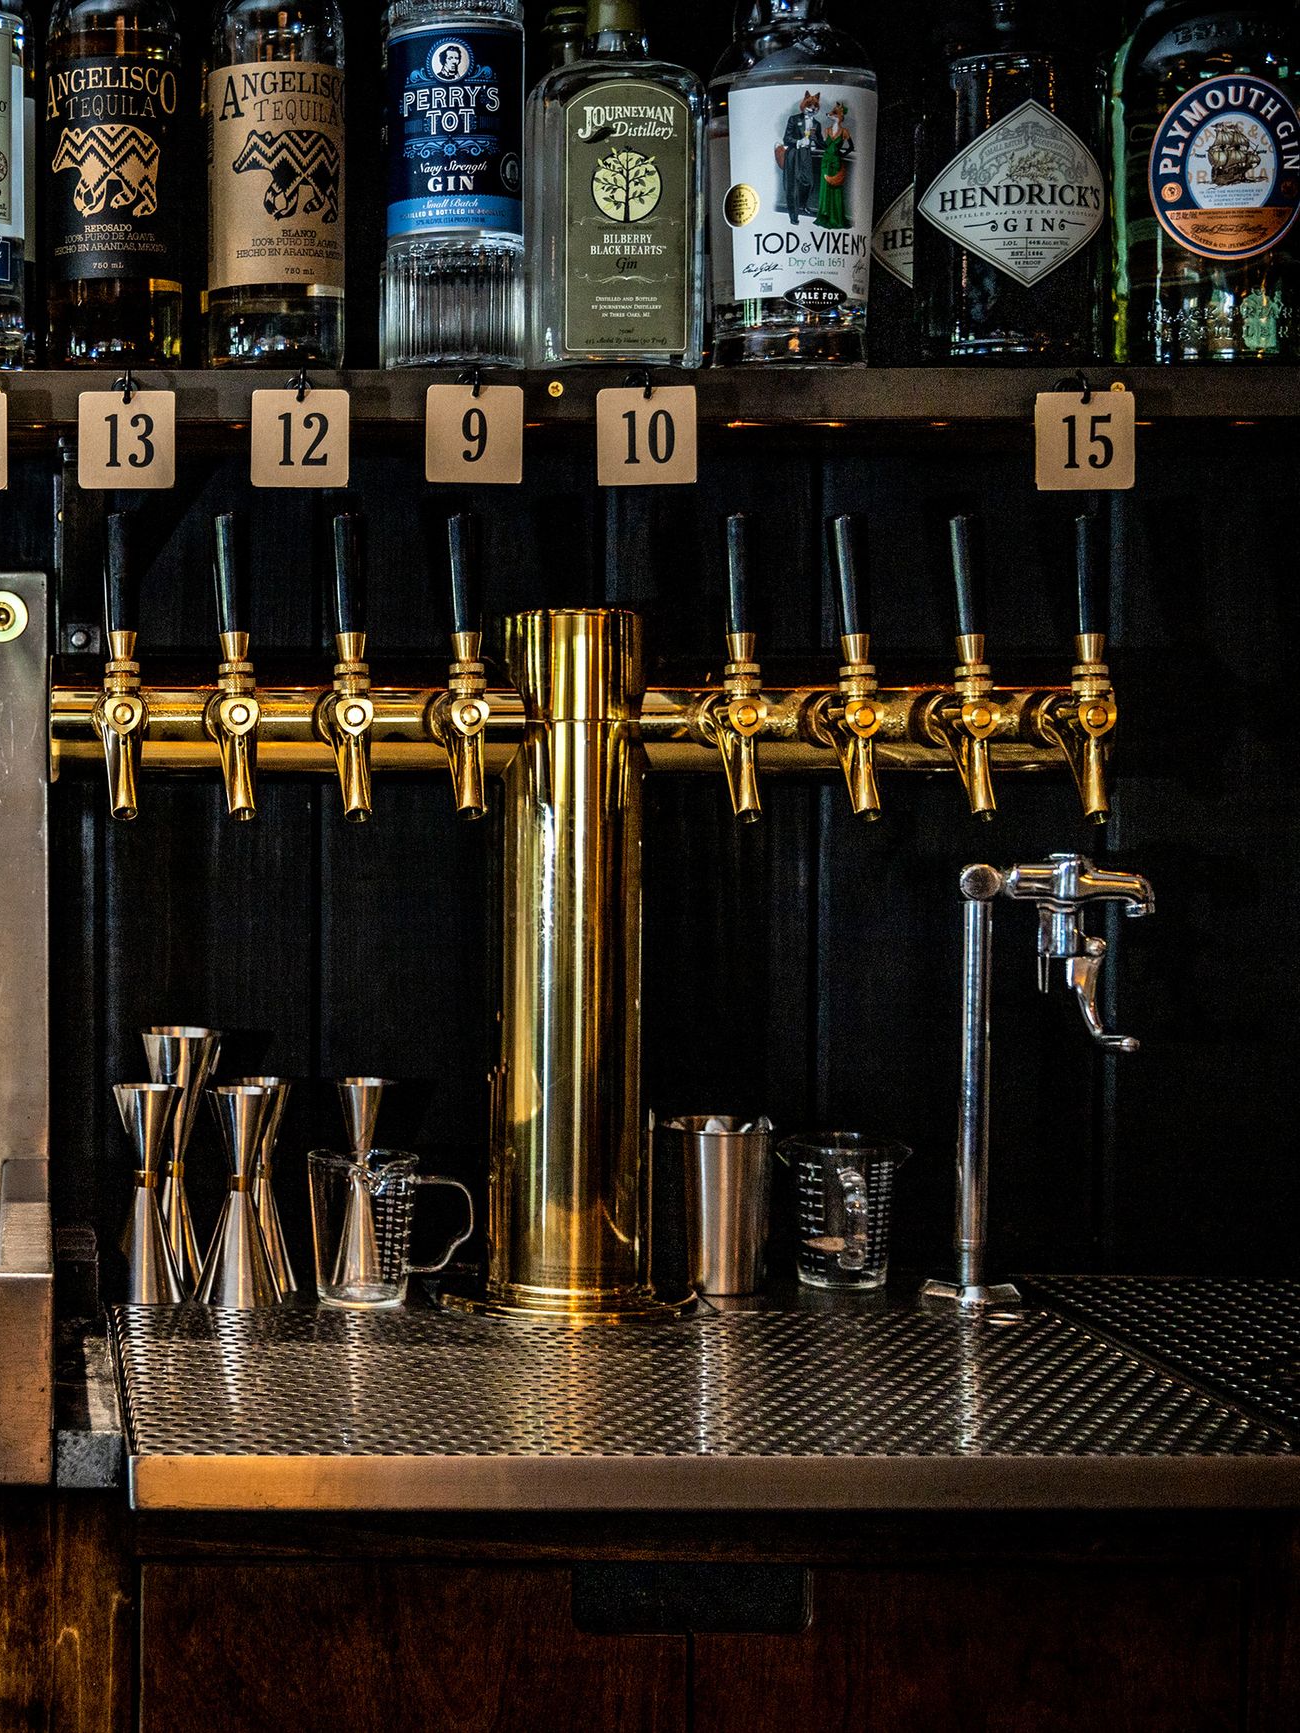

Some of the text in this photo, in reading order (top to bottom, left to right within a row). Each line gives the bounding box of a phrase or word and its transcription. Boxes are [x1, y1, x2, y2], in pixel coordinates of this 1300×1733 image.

[45, 66, 177, 121] ANGELISCO
[403, 85, 500, 117] PERRY'S
[65, 94, 156, 120] TEQUILA
[254, 99, 338, 126] TEQUILA
[426, 108, 475, 135] TOT
[577, 106, 675, 139] JOURNEYMAN
[610, 121, 674, 140] Distillery
[1159, 85, 1300, 176] PLYMOUTH GIN
[413, 160, 488, 176] Navy Strength
[427, 175, 474, 192] GIN
[422, 198, 479, 209] Small Batch
[938, 183, 1100, 213] HENDRICK'S
[84, 224, 132, 233] REPOSADO
[281, 229, 317, 238] BLANCO
[1004, 218, 1055, 232] GIN
[85, 232, 110, 241] PURO
[111, 232, 124, 240] DE
[251, 238, 316, 247] 100% PURO DE
[603, 234, 653, 244] BILBERRY
[754, 231, 867, 258] TOD & VIXEN'S
[78, 242, 137, 252] EN ARANDAS,
[236, 249, 266, 258] HECHO
[268, 248, 281, 256] EN
[590, 245, 663, 255] BLACK HEARTS
[616, 257, 637, 273] Gin
[788, 257, 845, 269] Dry Gin 1651
[794, 292, 819, 300] VALE
[104, 412, 155, 468] 13
[277, 412, 329, 466] 12
[461, 407, 488, 463] 9
[621, 409, 676, 464] 10
[1062, 413, 1114, 469] 15
